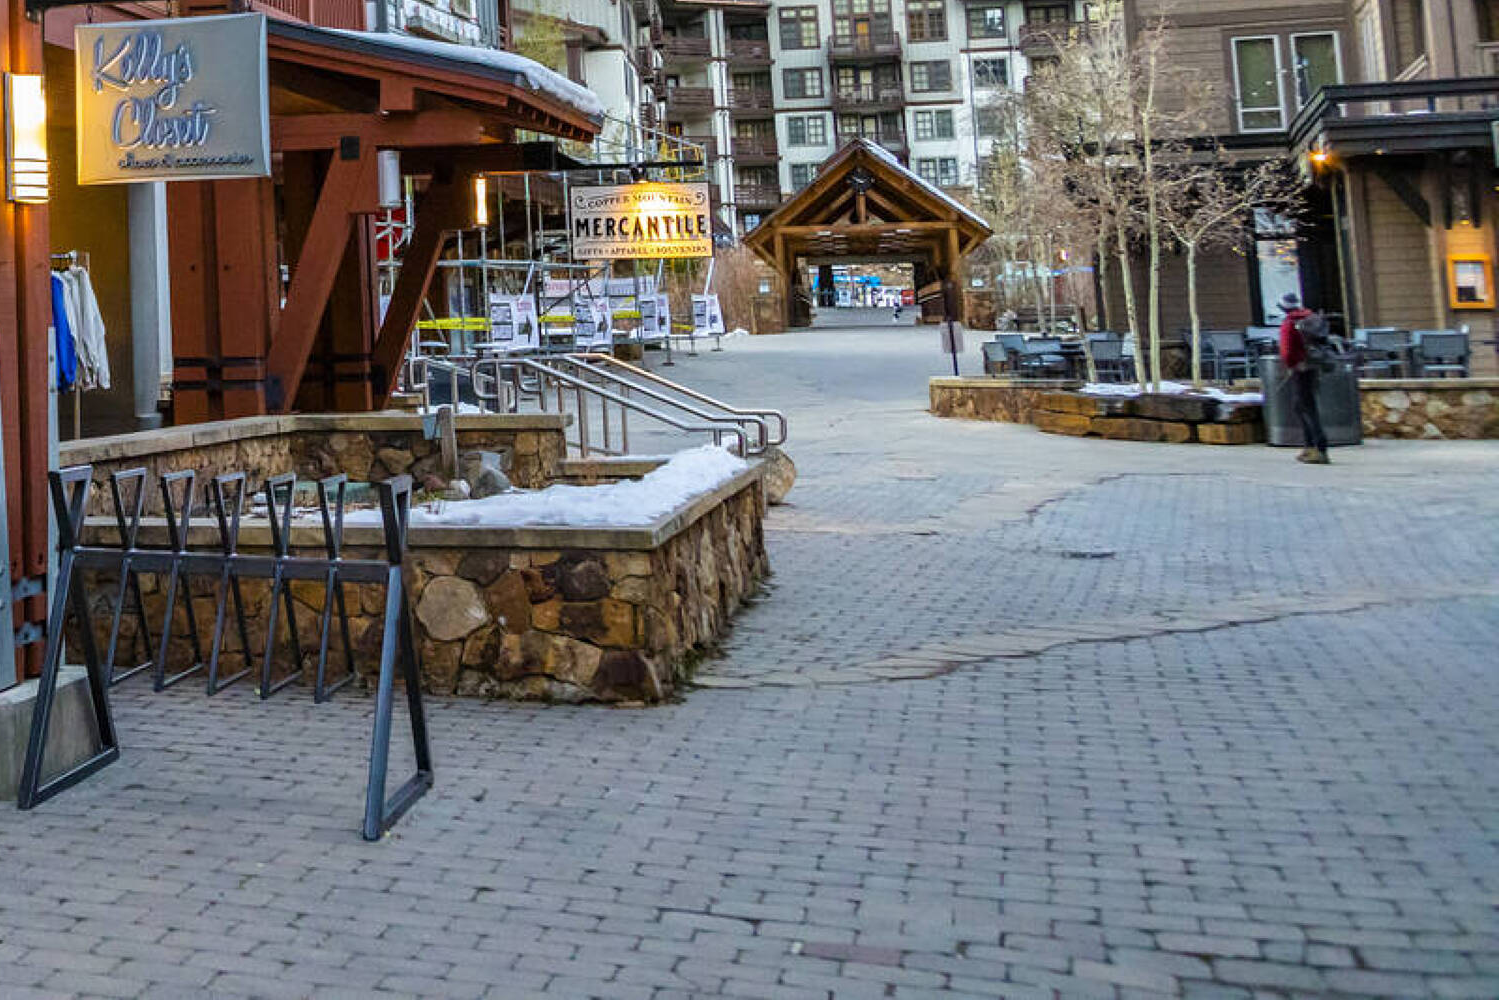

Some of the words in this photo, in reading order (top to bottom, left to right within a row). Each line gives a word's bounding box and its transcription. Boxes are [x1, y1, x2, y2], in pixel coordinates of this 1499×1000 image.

[93, 31, 193, 110] Kelly's
[112, 97, 217, 150] Closet
[576, 214, 707, 238] MERCANTILE
